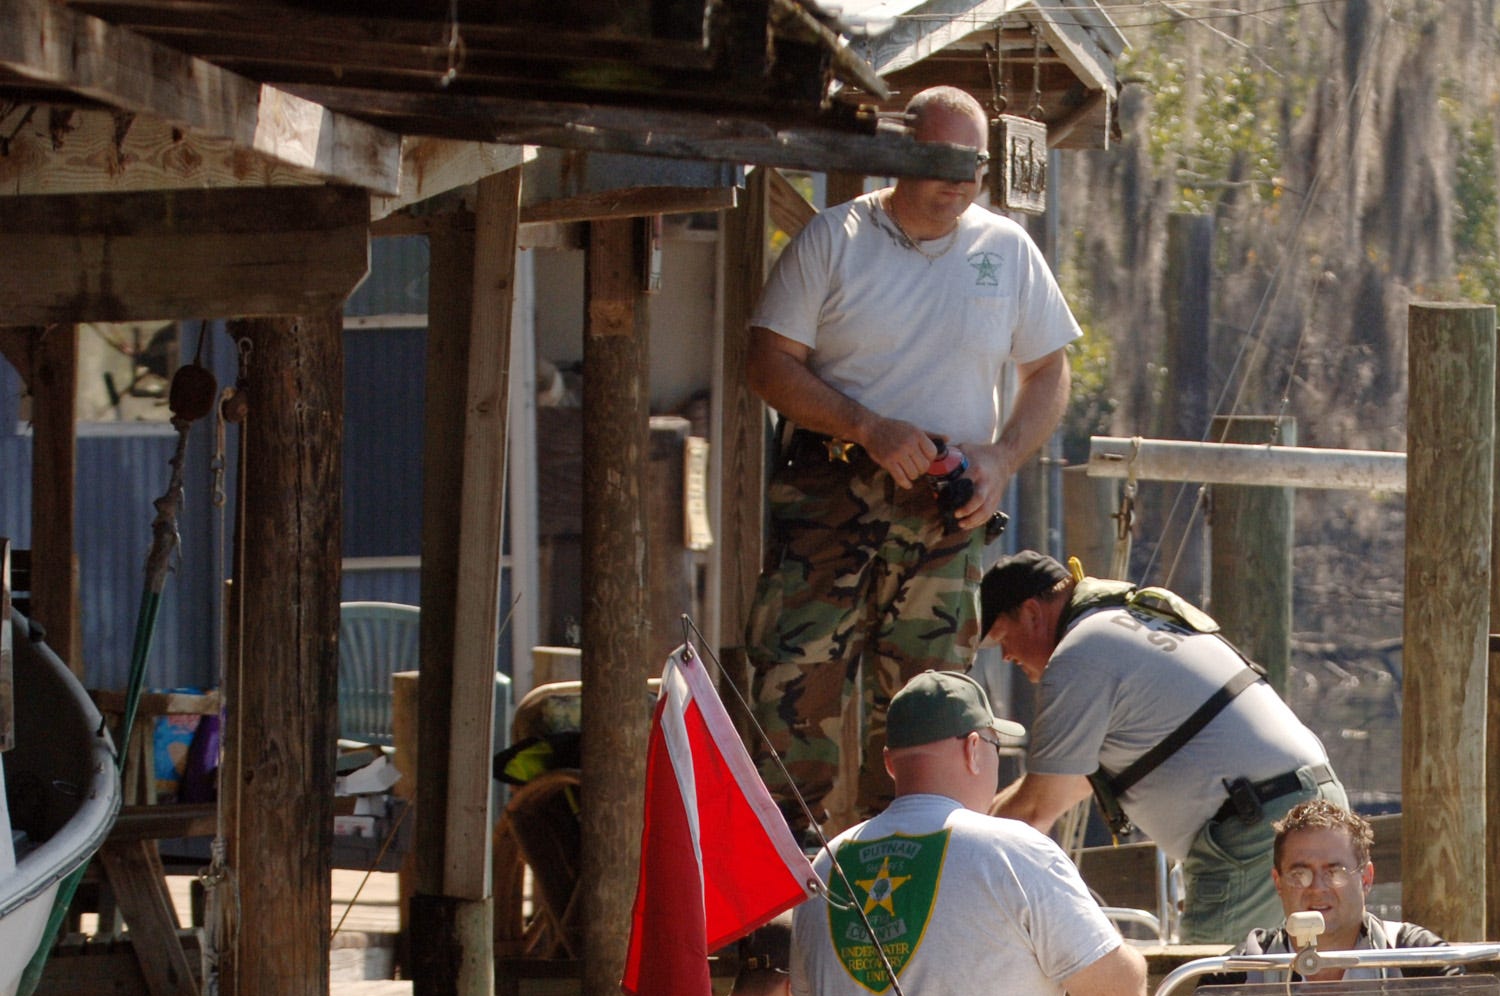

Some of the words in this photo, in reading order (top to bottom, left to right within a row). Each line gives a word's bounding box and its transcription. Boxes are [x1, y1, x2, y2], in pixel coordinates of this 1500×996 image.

[862, 841, 919, 860] PUTNAM
[850, 919, 901, 939] CONTY
[841, 942, 910, 958] UNDERATER
[848, 956, 904, 970] RECOVRY
[866, 971, 891, 982] UNI
